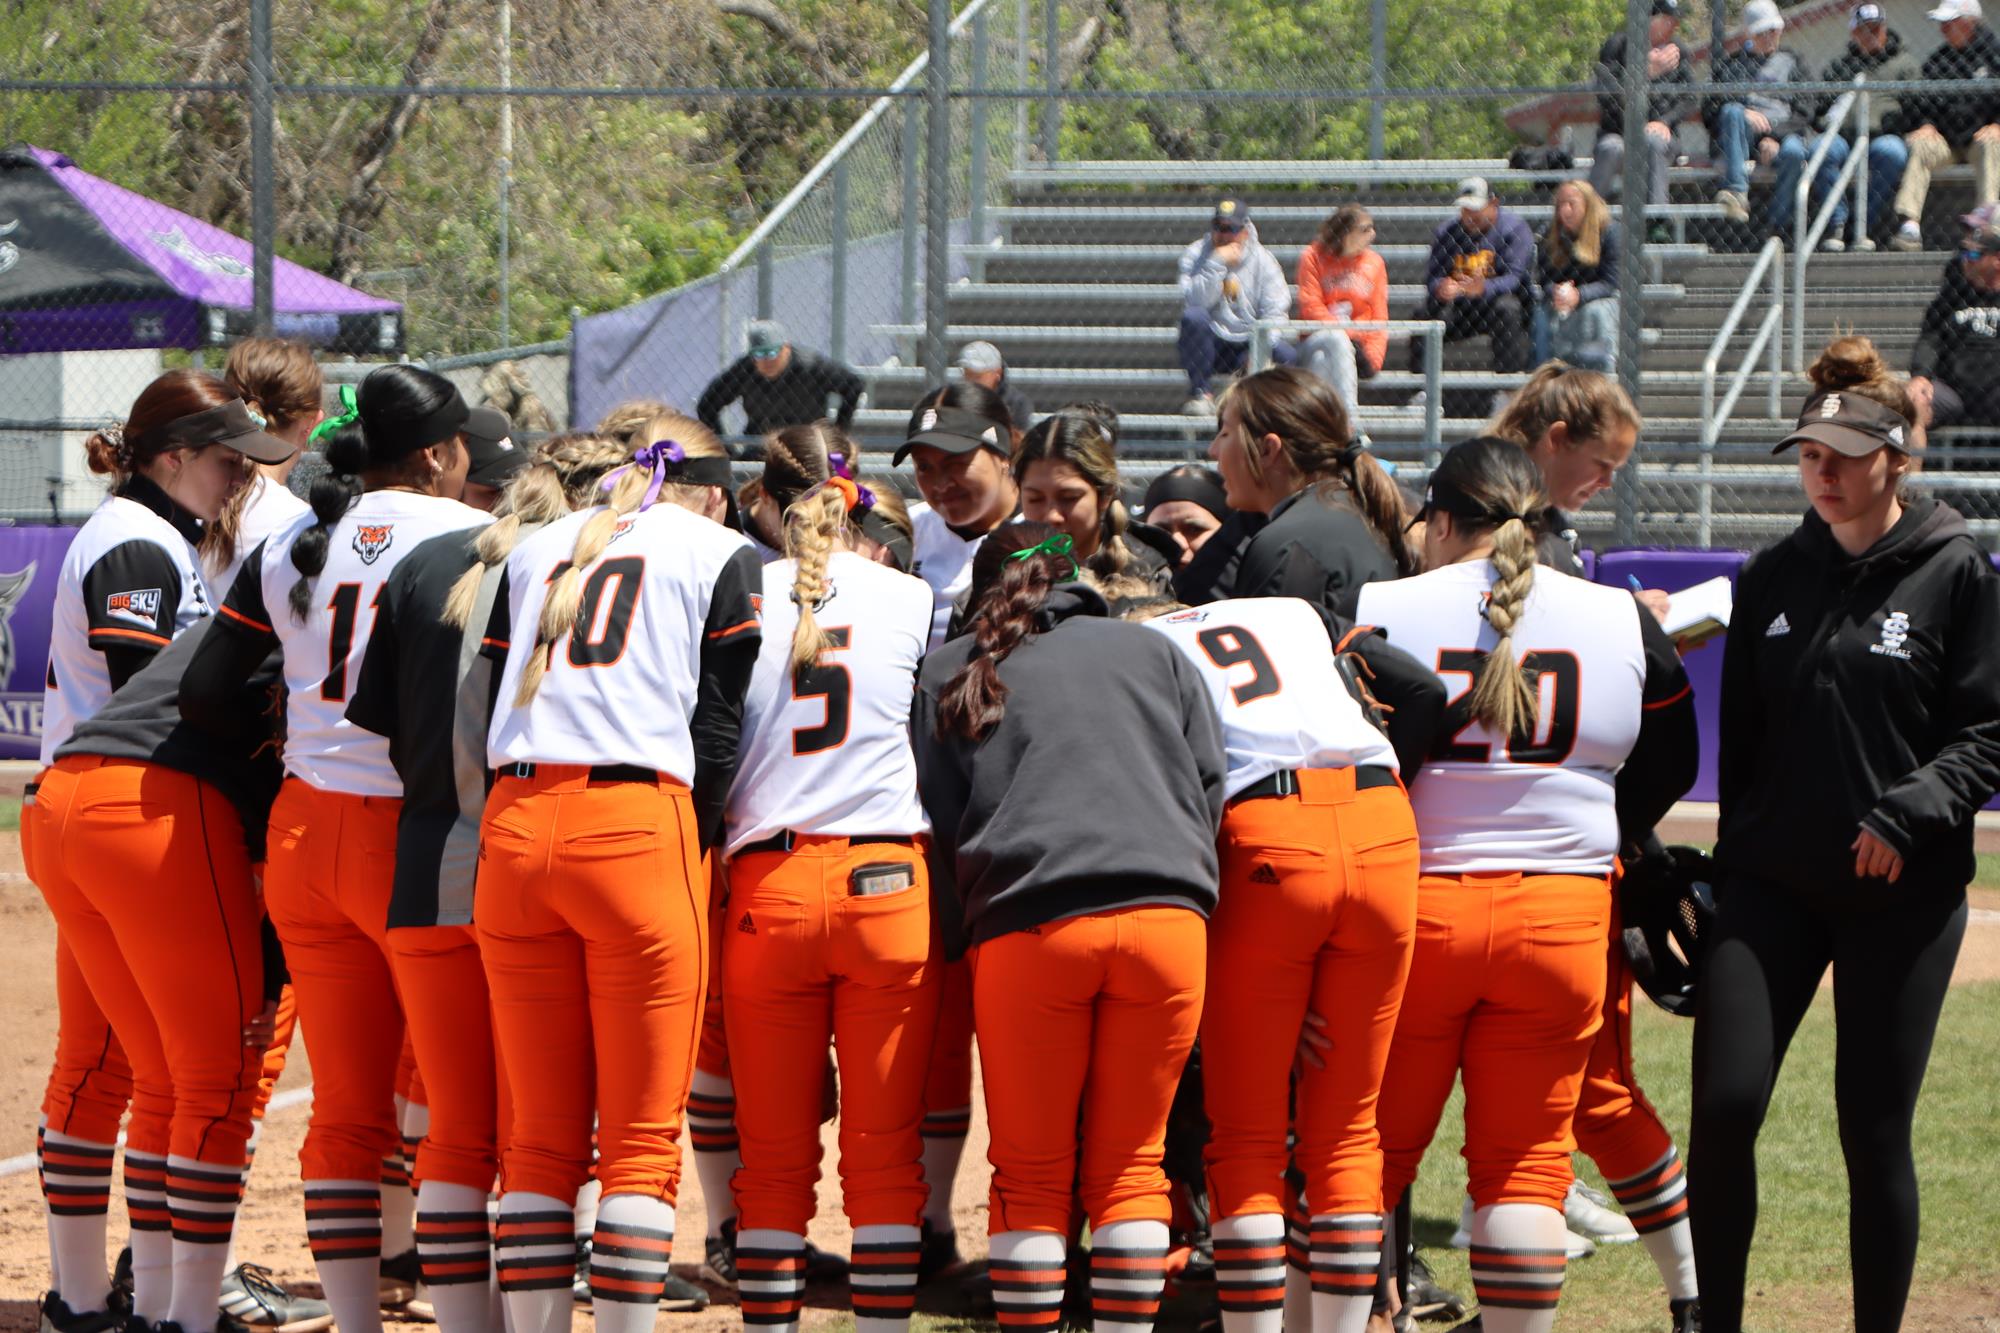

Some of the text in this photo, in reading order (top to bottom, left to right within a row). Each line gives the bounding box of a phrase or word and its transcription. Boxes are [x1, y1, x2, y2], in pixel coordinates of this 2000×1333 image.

[792, 624, 853, 757] 5
[1195, 624, 1282, 708] 9
[1426, 648, 1582, 767] 20
